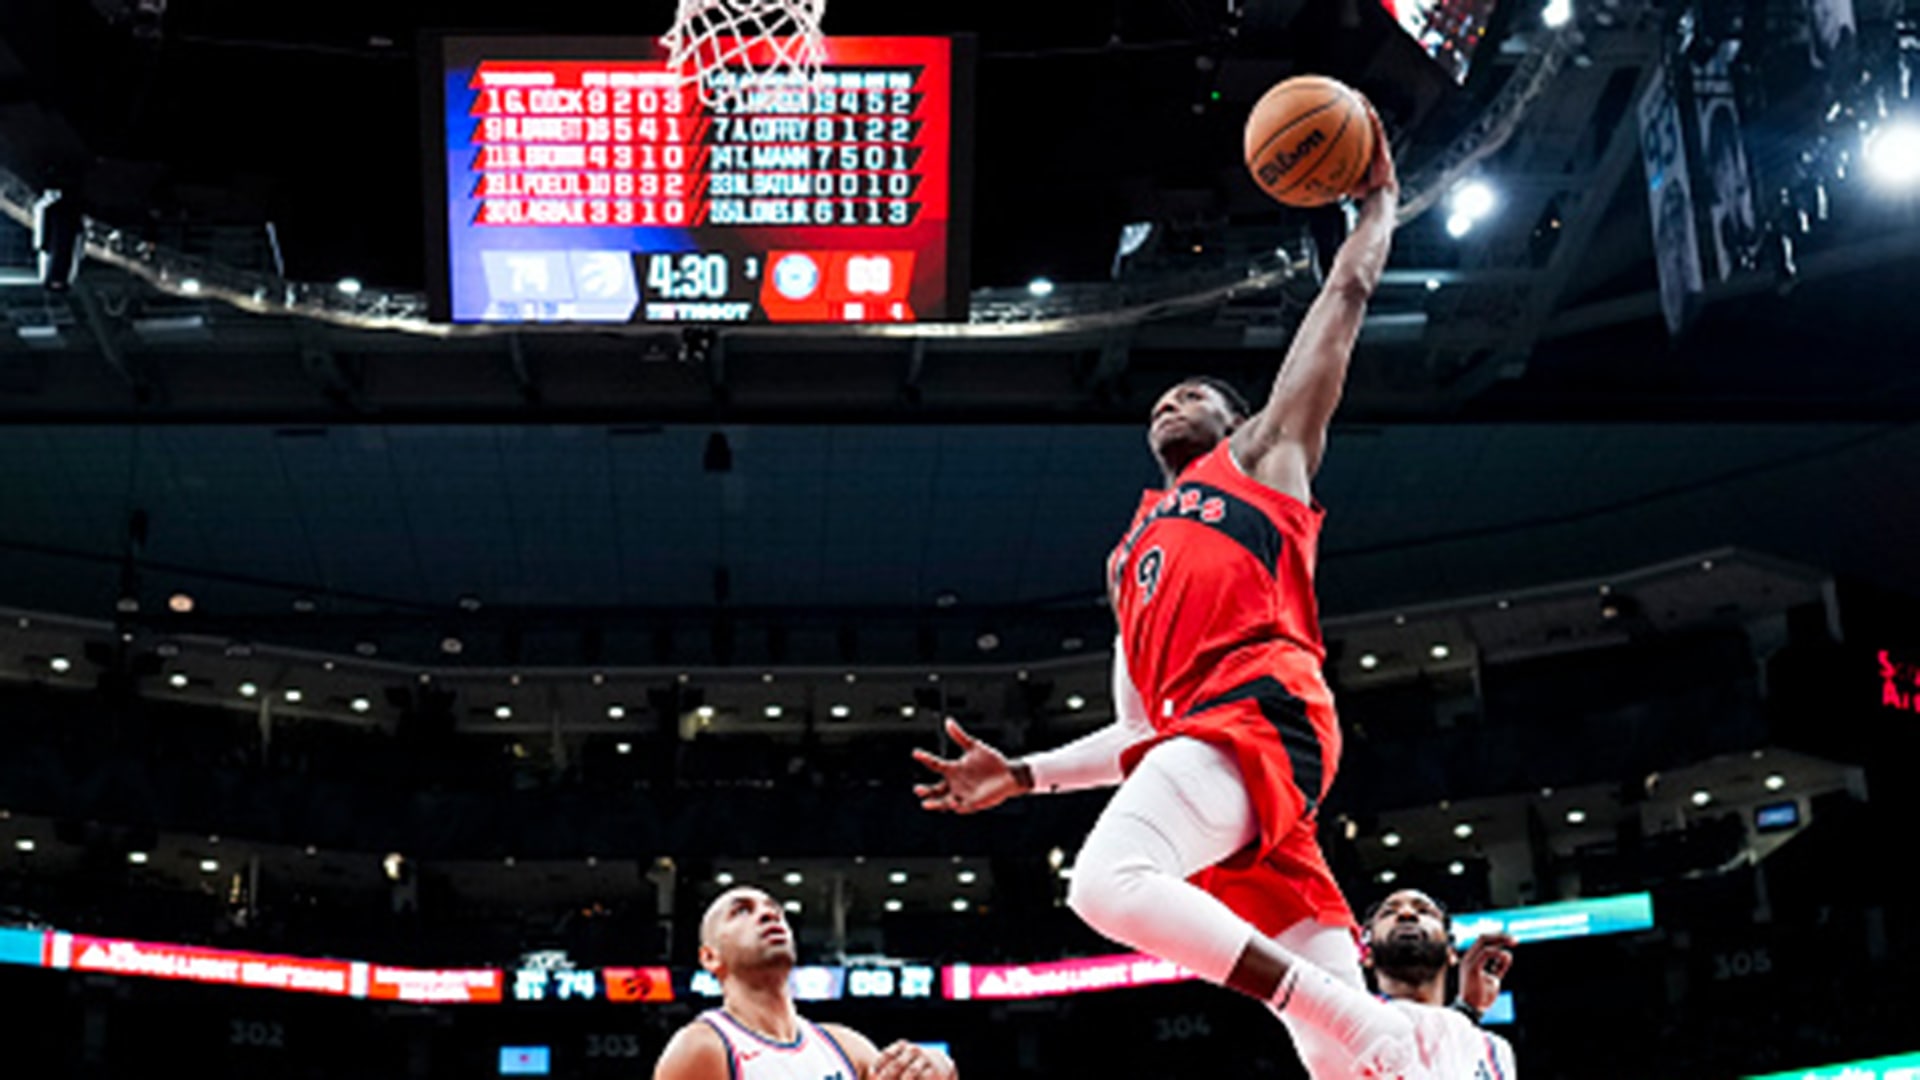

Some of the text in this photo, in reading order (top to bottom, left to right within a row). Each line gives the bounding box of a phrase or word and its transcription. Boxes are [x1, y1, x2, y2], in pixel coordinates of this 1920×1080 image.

[488, 90, 500, 113] 1
[614, 90, 631, 113] 2
[638, 90, 658, 113] 0
[664, 90, 682, 113] 3
[840, 90, 858, 113] 4
[891, 90, 910, 113] 2
[614, 118, 631, 141] 5
[639, 118, 656, 141] 4
[666, 118, 680, 141] 1
[715, 118, 729, 141] 7
[815, 118, 834, 141] 8
[843, 118, 857, 141] 1
[866, 118, 885, 141] 2
[891, 118, 910, 141] 2
[590, 146, 607, 168] 4
[614, 146, 632, 168] 3
[642, 146, 656, 168] 1
[665, 146, 683, 168] 0
[815, 146, 832, 168] 7
[840, 146, 858, 168] 5
[865, 146, 884, 168] 0
[892, 146, 906, 168] 1
[615, 173, 633, 195] 8
[640, 173, 658, 195] 3
[665, 173, 683, 195] 2
[815, 173, 834, 195] 0
[840, 173, 859, 195] 0
[867, 173, 882, 195] 1
[889, 173, 908, 195] 0
[590, 200, 608, 223] 3
[614, 200, 633, 223] 3
[642, 200, 656, 223] 1
[665, 200, 683, 223] 0
[815, 200, 834, 223] 6
[841, 200, 856, 223] 1
[867, 200, 882, 223] 1
[888, 200, 908, 223] 3
[647, 254, 728, 298] 4:30
[1136, 545, 1165, 604] 9
[553, 969, 596, 999] 74
[229, 1019, 285, 1047] 302
[585, 1034, 640, 1058] 303
